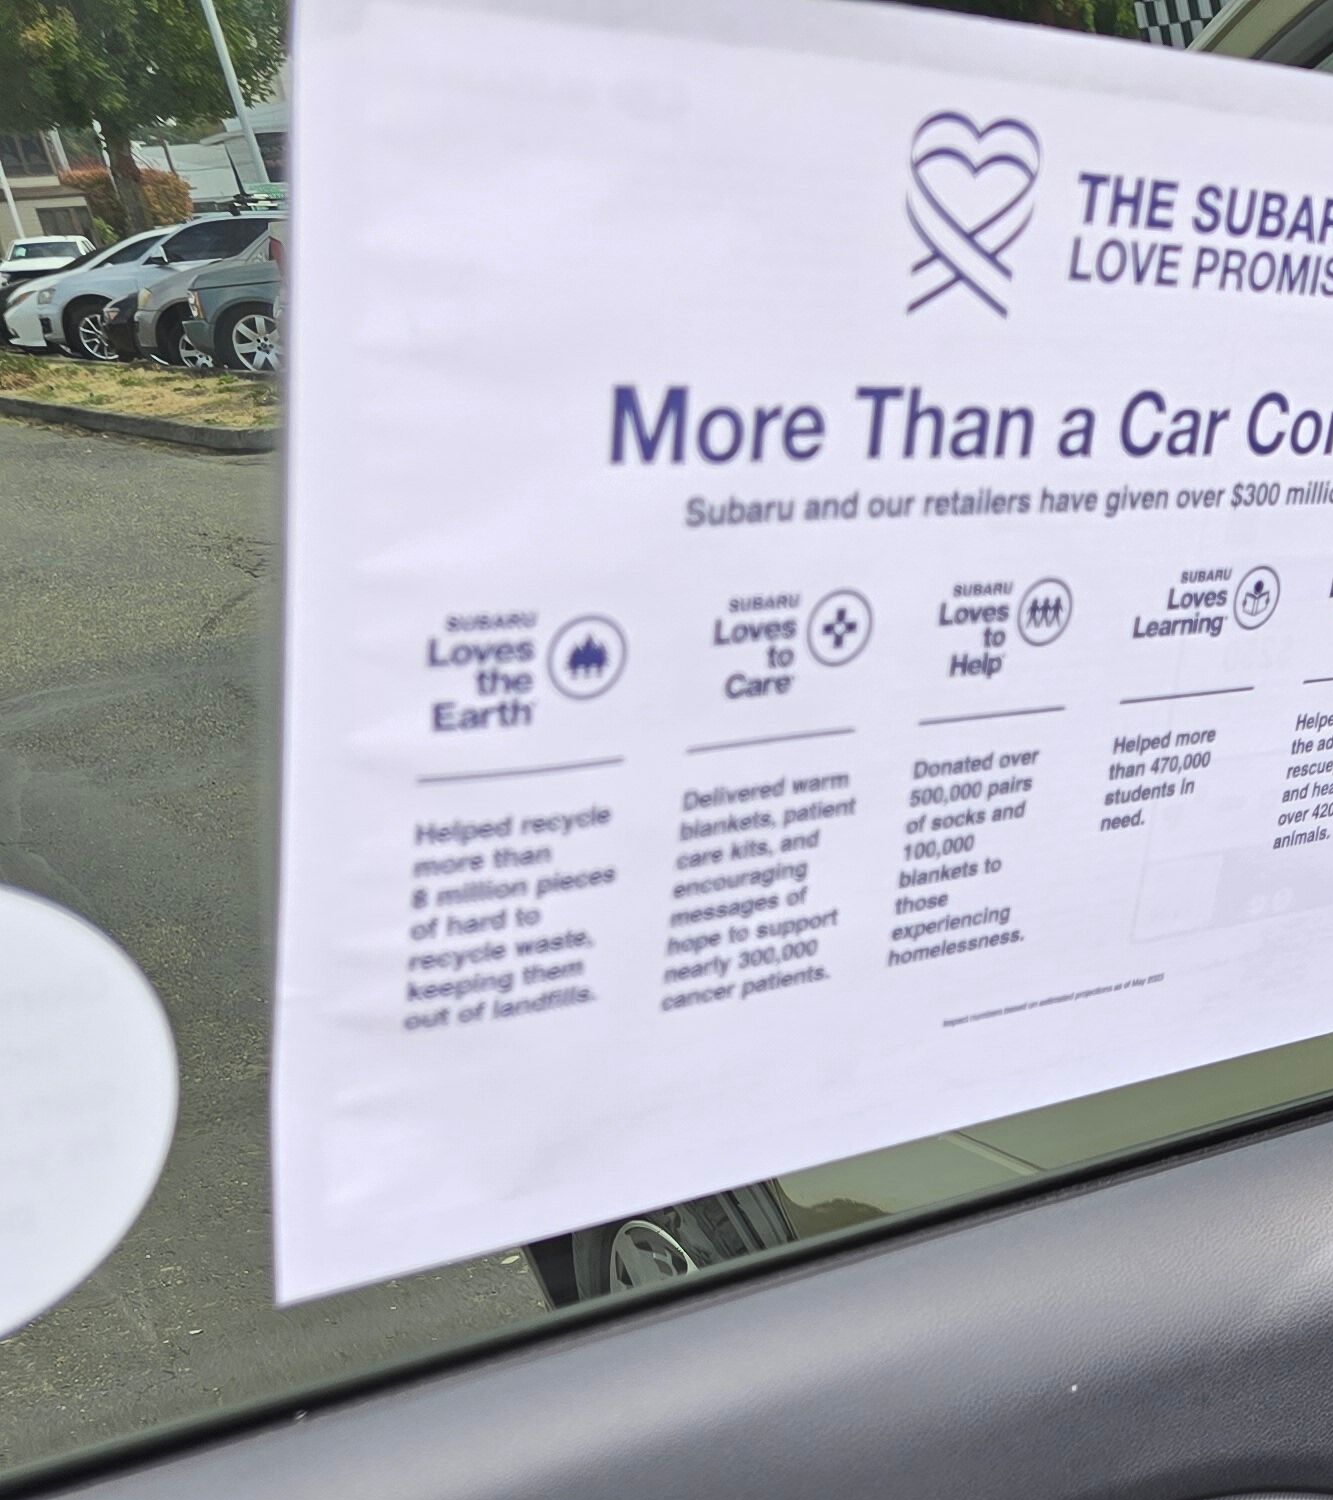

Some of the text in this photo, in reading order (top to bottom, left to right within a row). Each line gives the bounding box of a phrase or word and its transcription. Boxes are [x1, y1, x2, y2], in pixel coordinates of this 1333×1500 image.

[1079, 171, 1180, 231] THE
[1068, 237, 1181, 287] LOVE
[610, 384, 826, 464] More
[856, 386, 1035, 460] Than
[1058, 406, 1096, 458] a
[1120, 390, 1230, 458] Car
[685, 497, 795, 528] Subaru
[804, 491, 859, 521] and
[868, 494, 914, 518] our
[923, 487, 1030, 516] retailers
[1041, 487, 1097, 514] have
[1105, 484, 1168, 517] given
[1177, 486, 1225, 510] over
[1231, 481, 1281, 509] $300
[953, 582, 1014, 597] SUBARU
[1180, 568, 1232, 585] SUBARU
[729, 593, 802, 613] SUBARU
[938, 602, 1010, 626] Loves
[1167, 588, 1228, 610] Loves
[446, 612, 539, 632] SUBARU
[714, 619, 797, 646] Loves
[983, 627, 1006, 648] to
[1133, 612, 1224, 639] Learning
[428, 638, 534, 667] Loves
[767, 645, 795, 669] to
[949, 652, 1002, 679] Help
[477, 670, 533, 695] the
[725, 673, 791, 699] Care
[432, 699, 532, 732] Earth
[1112, 727, 1216, 755] Helped more
[1291, 738, 1314, 755] the
[913, 749, 1040, 780] Donated over
[1108, 752, 1211, 780] than 470,000
[681, 772, 849, 812] Delivered warm
[909, 775, 1033, 808] 500,000 pairs
[1104, 778, 1195, 806] students in
[1281, 785, 1310, 803] and
[414, 804, 612, 847] Helped recycle
[679, 798, 856, 843] blankets, patient
[905, 800, 1026, 835] of socks and
[1100, 809, 1144, 832] need.
[1278, 809, 1308, 826] over
[676, 830, 821, 870] care kits, and
[903, 835, 975, 861] 100,000
[1272, 826, 1331, 850] animals.
[413, 845, 551, 878] more than
[897, 857, 1002, 889] blankets to
[436, 878, 527, 906] million
[536, 866, 616, 898] pieces
[672, 862, 808, 899] encouraging
[669, 886, 808, 927] messages of
[894, 892, 949, 915] those
[410, 906, 542, 941] of hard to
[666, 908, 839, 957] hope to support
[891, 905, 1011, 942] experiencing
[408, 929, 593, 973] recycle waste,
[664, 939, 819, 984] nearly 300,000
[887, 927, 1024, 966] homelessness.
[406, 959, 584, 1002] keeping them
[661, 963, 830, 1012] cancer patients.
[404, 986, 595, 1031] out of landfills.
